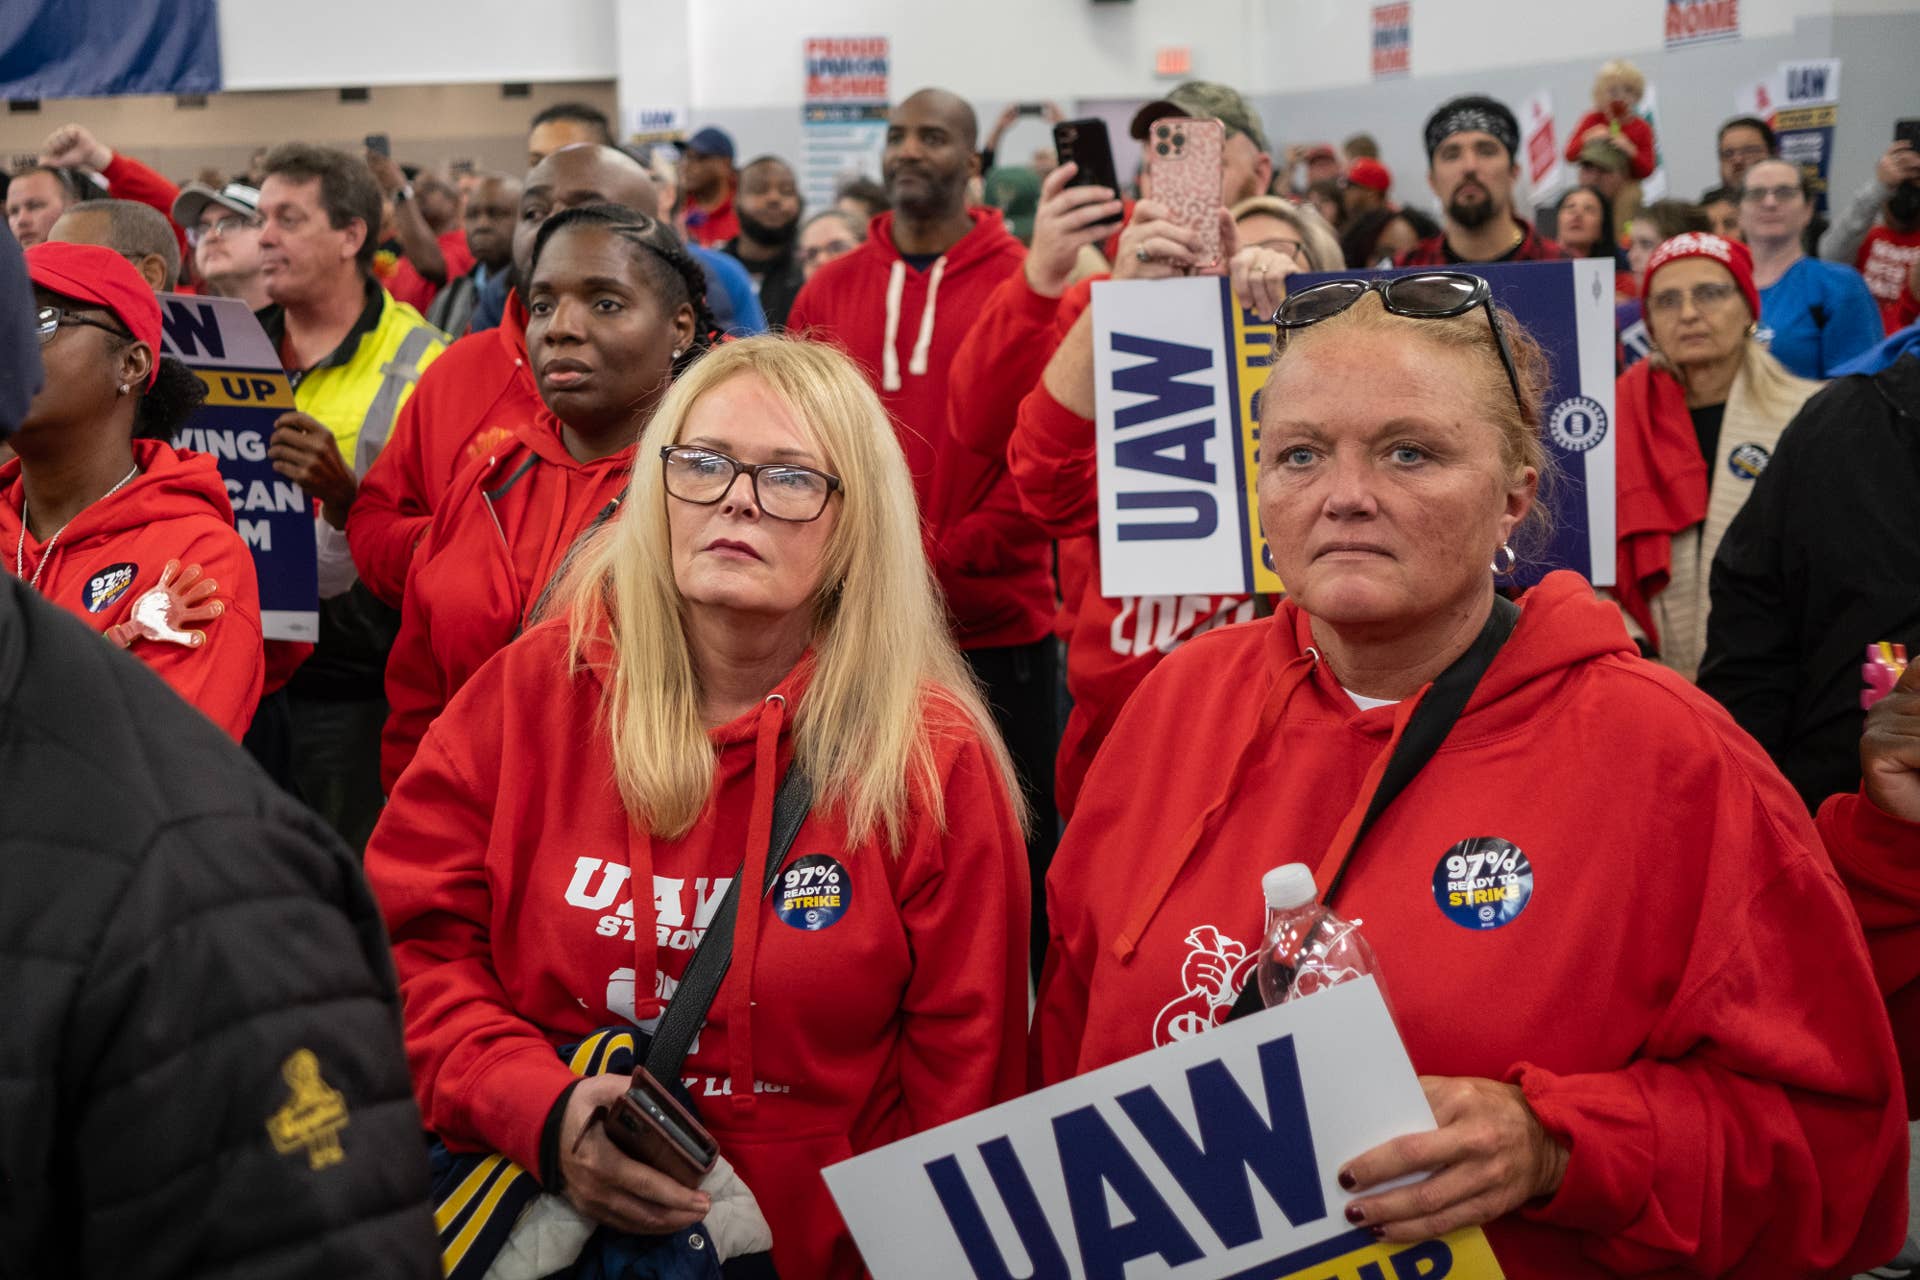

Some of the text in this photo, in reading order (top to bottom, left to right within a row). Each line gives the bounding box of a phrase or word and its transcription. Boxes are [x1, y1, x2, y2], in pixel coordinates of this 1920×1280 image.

[1787, 67, 1831, 100] UAW
[220, 377, 276, 400] UP
[1110, 331, 1218, 542] UAW
[91, 565, 132, 591] 97%
[1446, 849, 1516, 879] 97%
[784, 865, 839, 888] 97%
[1448, 873, 1518, 891] READY TO
[784, 885, 840, 899] READY TO
[784, 895, 840, 911] STRIKE
[1449, 884, 1520, 907] STRIKE
[596, 915, 707, 951] STRON
[923, 1034, 1327, 1280] UAW
